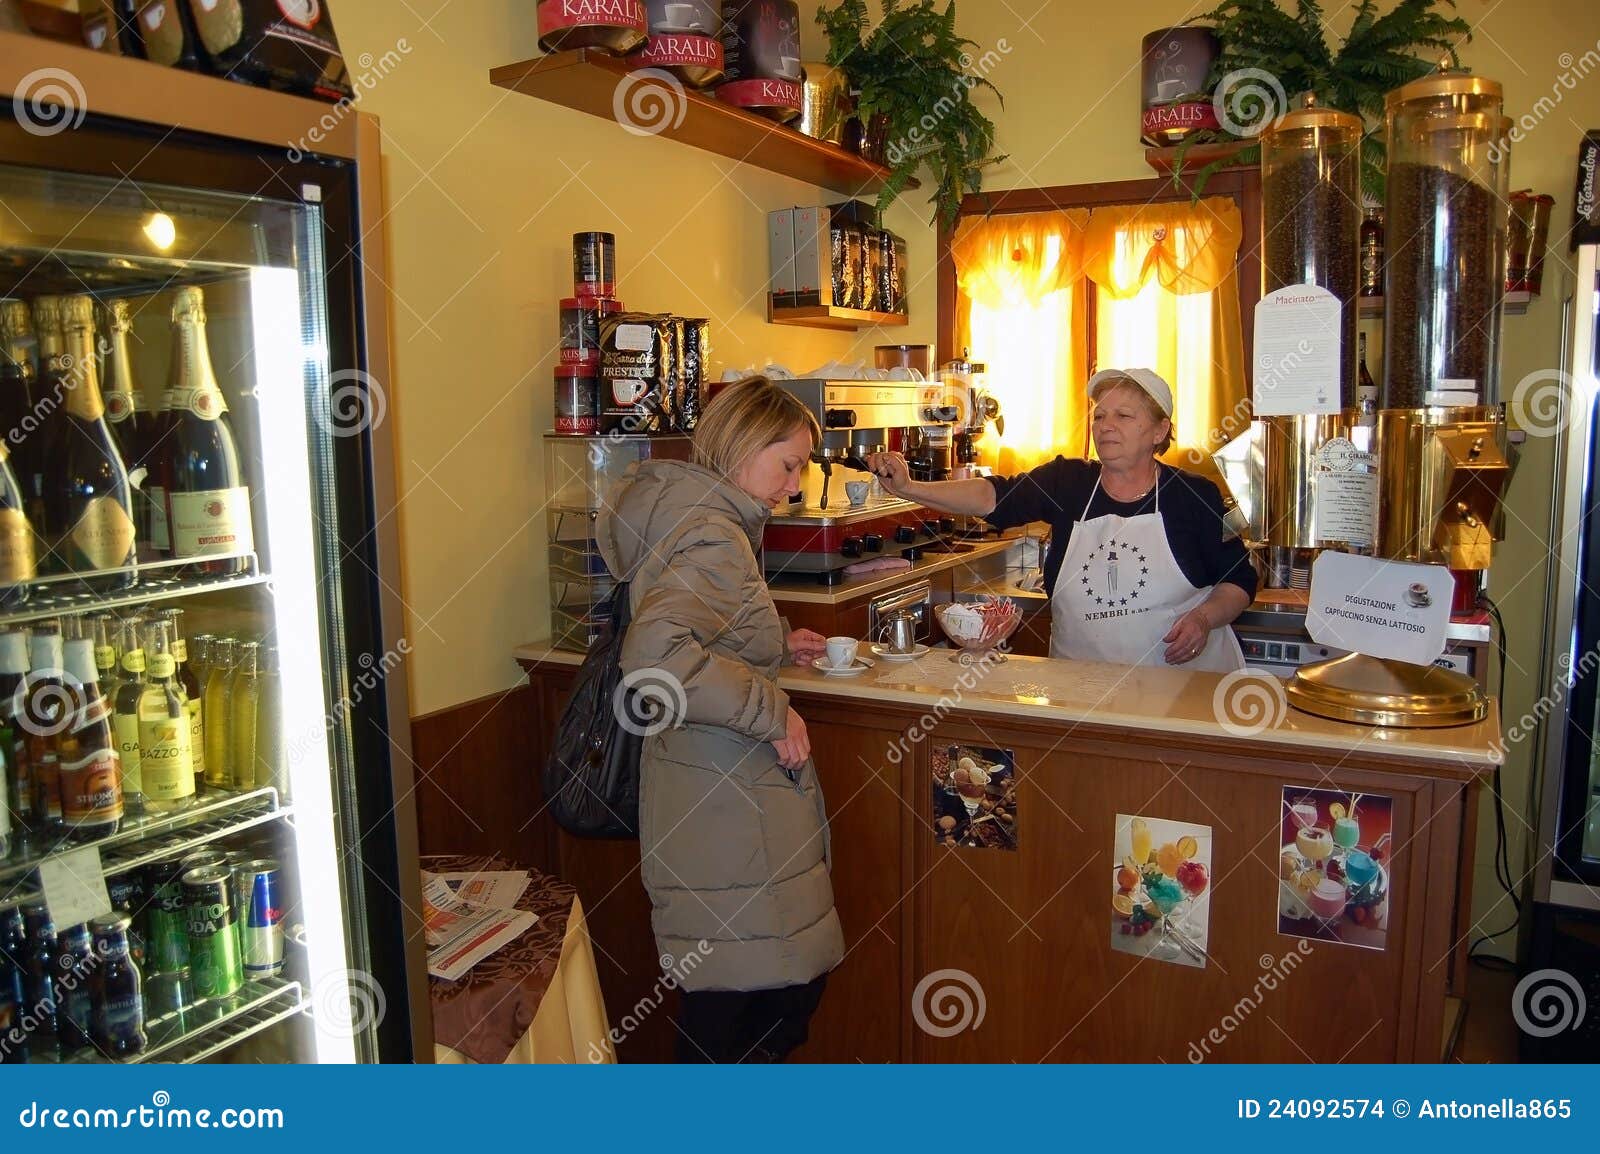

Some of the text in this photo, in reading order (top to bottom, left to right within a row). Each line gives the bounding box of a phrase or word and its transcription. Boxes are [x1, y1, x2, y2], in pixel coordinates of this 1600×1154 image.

[563, 0, 644, 22] KARALIS
[641, 38, 717, 60] KARALIS
[1143, 106, 1203, 126] KARALIS
[603, 367, 655, 378] PRESTIGE
[1345, 594, 1396, 612] DEGUSTAZIONE
[1085, 608, 1129, 621] NEMBRI
[1325, 606, 1426, 634] CAPPUCCINO SENZA LATTOSIO
